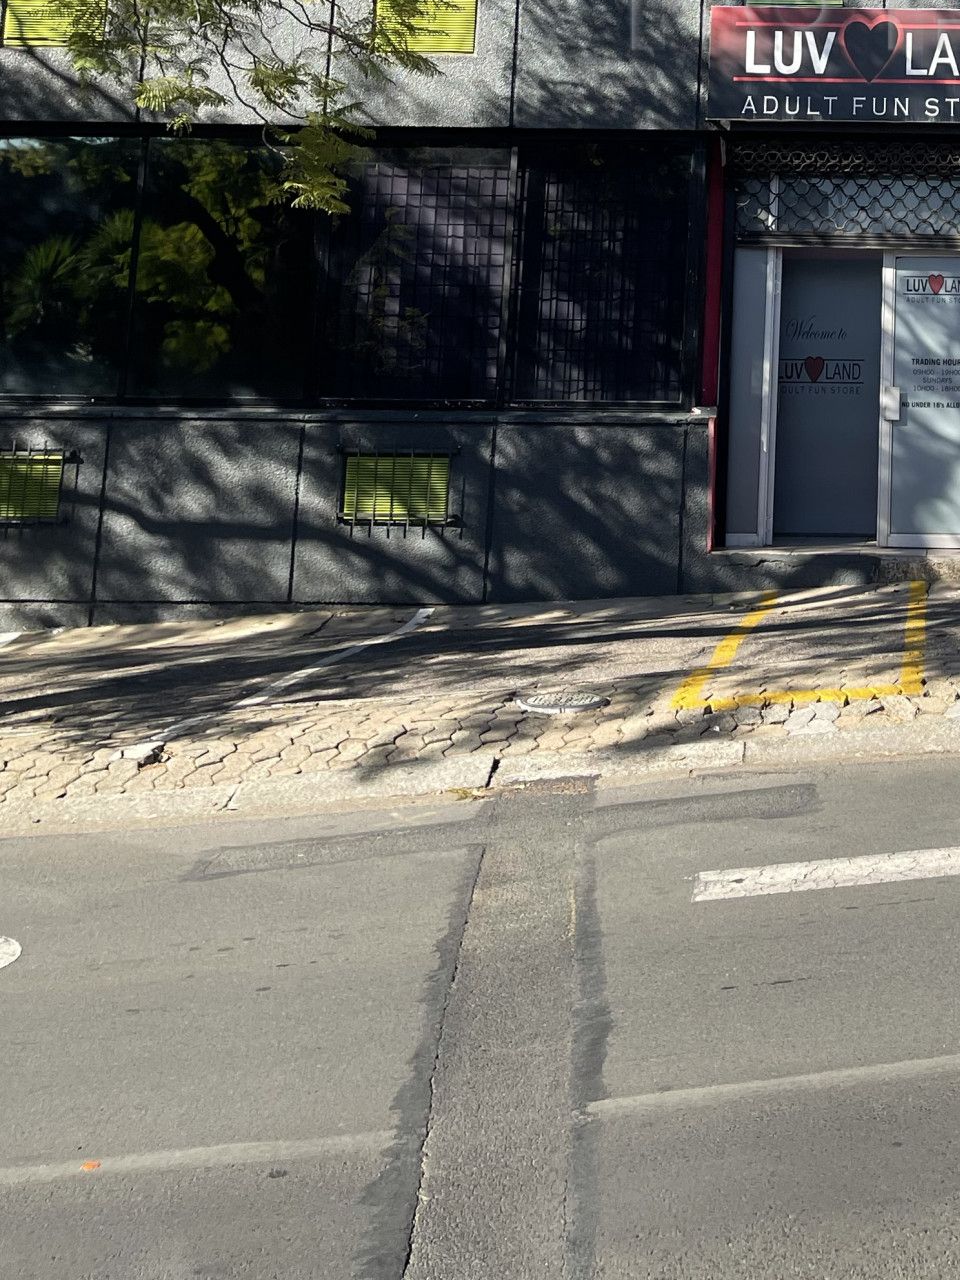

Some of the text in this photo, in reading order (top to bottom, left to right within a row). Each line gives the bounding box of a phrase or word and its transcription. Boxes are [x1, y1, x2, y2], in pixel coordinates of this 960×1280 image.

[745, 30, 836, 75] LUV
[741, 95, 838, 115] ADULT
[852, 96, 910, 117] FUN
[906, 278, 928, 293] LUV
[911, 358, 941, 366] TRADING
[825, 363, 861, 380] LAND
[780, 386, 804, 394] DULT
